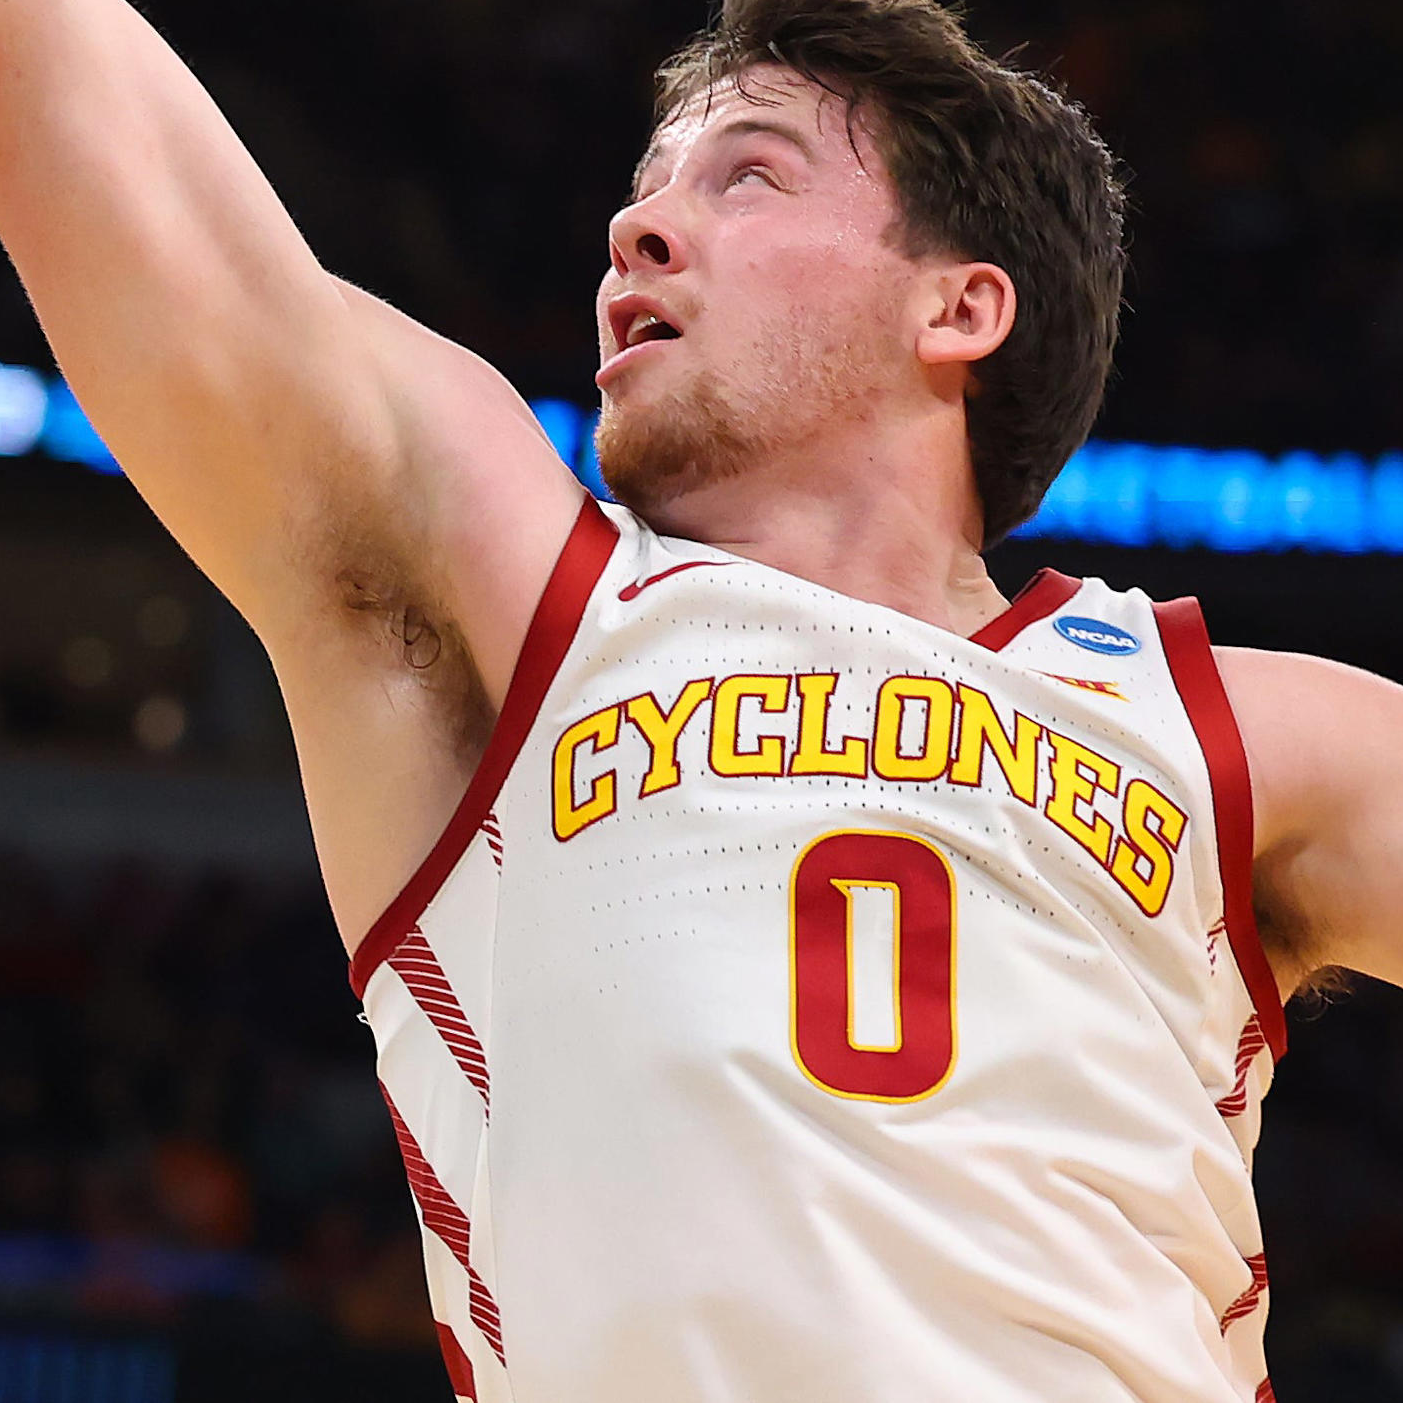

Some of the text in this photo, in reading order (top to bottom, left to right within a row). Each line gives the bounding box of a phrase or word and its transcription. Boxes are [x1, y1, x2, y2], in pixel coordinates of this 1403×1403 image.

[1066, 627, 1138, 649] NCAA
[551, 673, 1189, 918] CYCLONES
[788, 828, 959, 1105] 0
